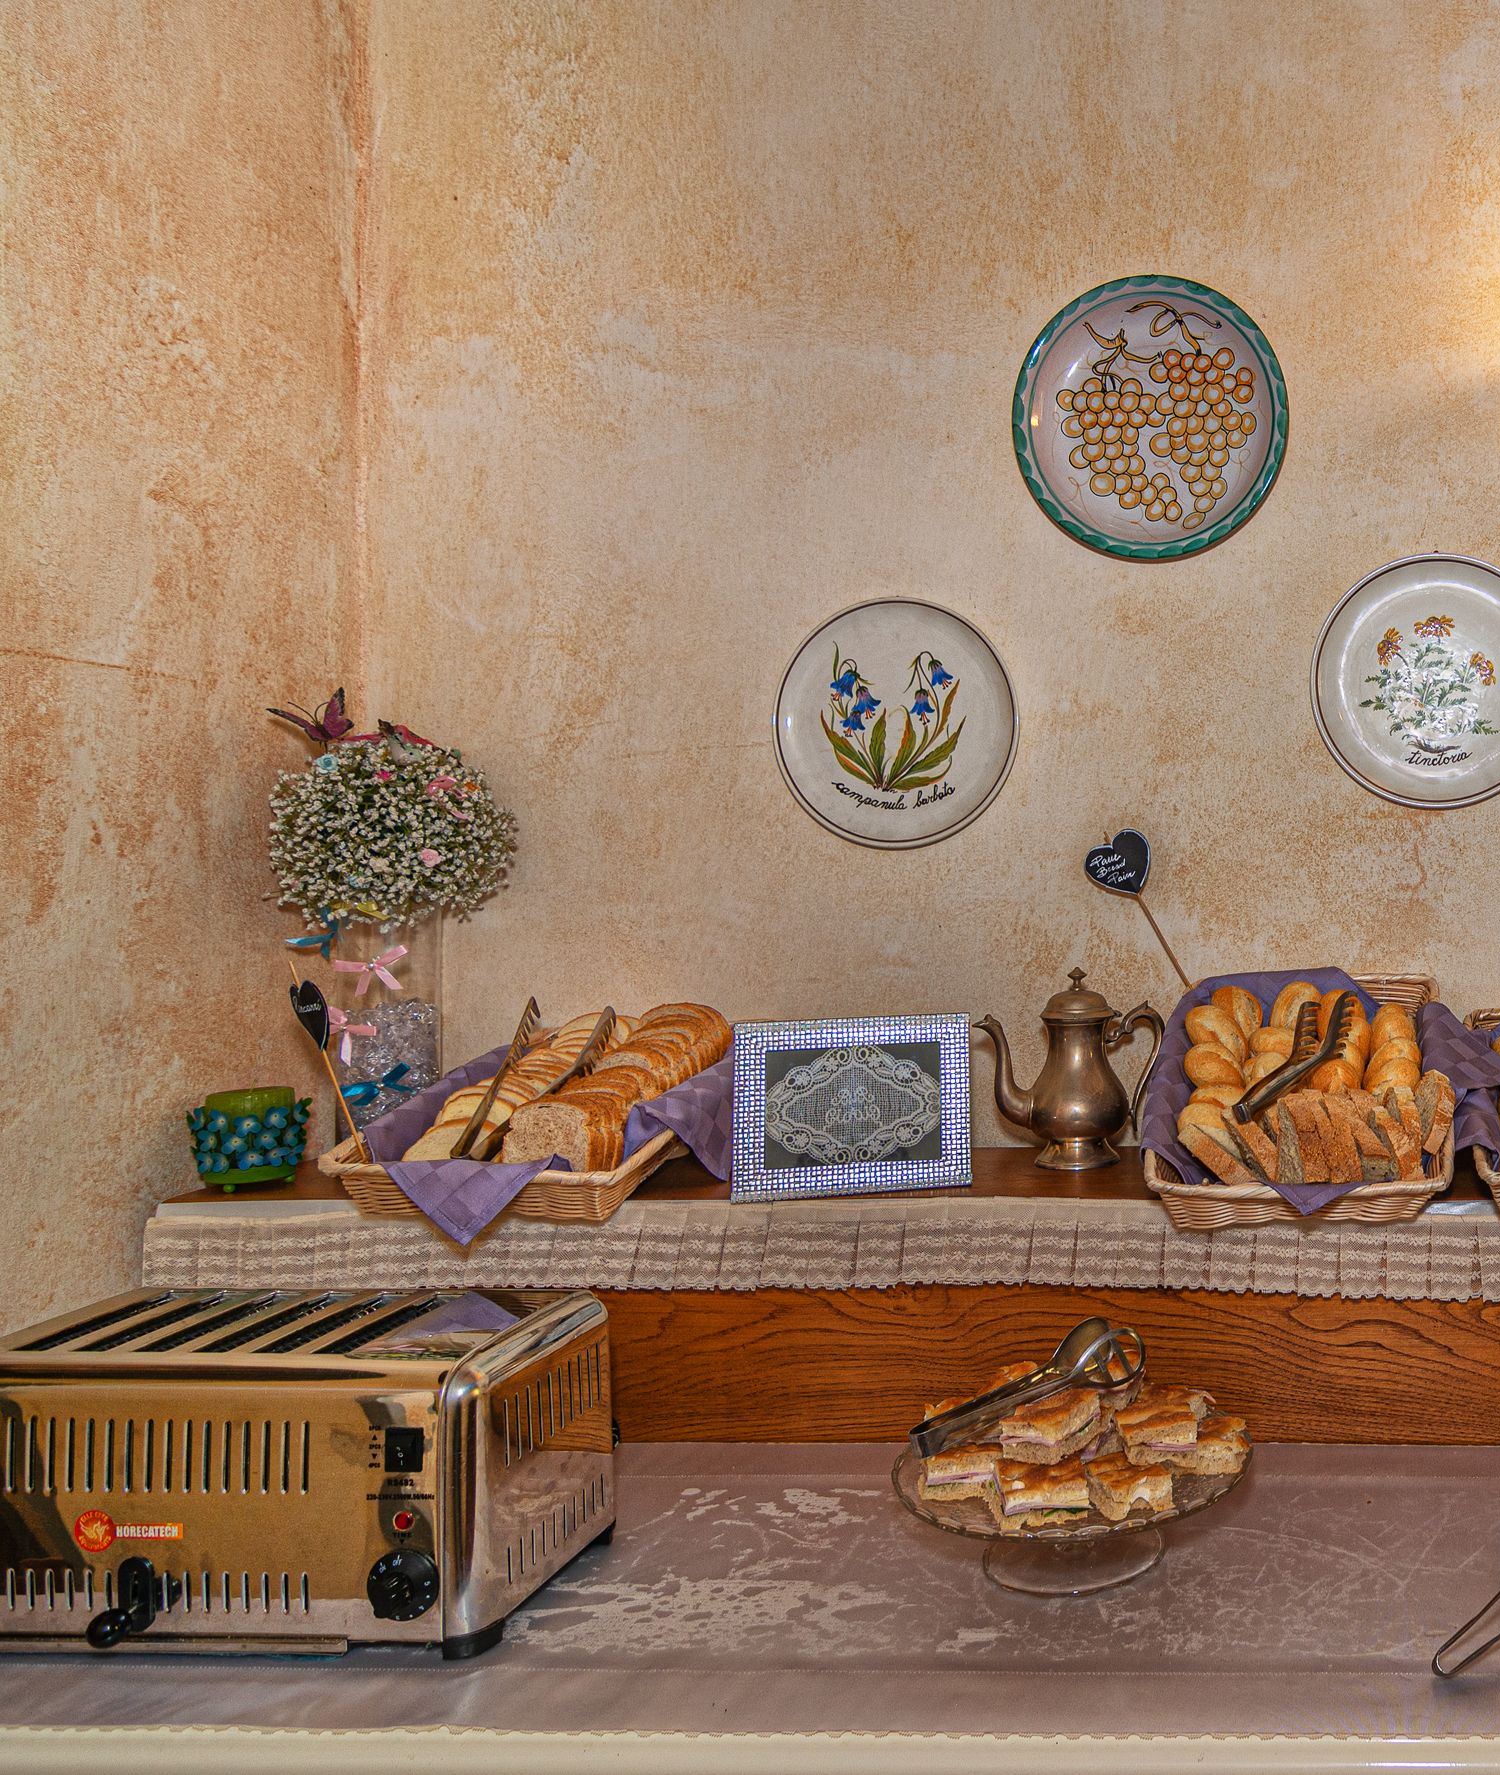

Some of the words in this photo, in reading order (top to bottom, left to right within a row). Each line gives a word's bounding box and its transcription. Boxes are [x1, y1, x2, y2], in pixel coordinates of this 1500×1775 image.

[1404, 750, 1473, 767] tinctoria
[831, 781, 907, 810] campanula
[116, 1525, 178, 1538] HORECATECH
